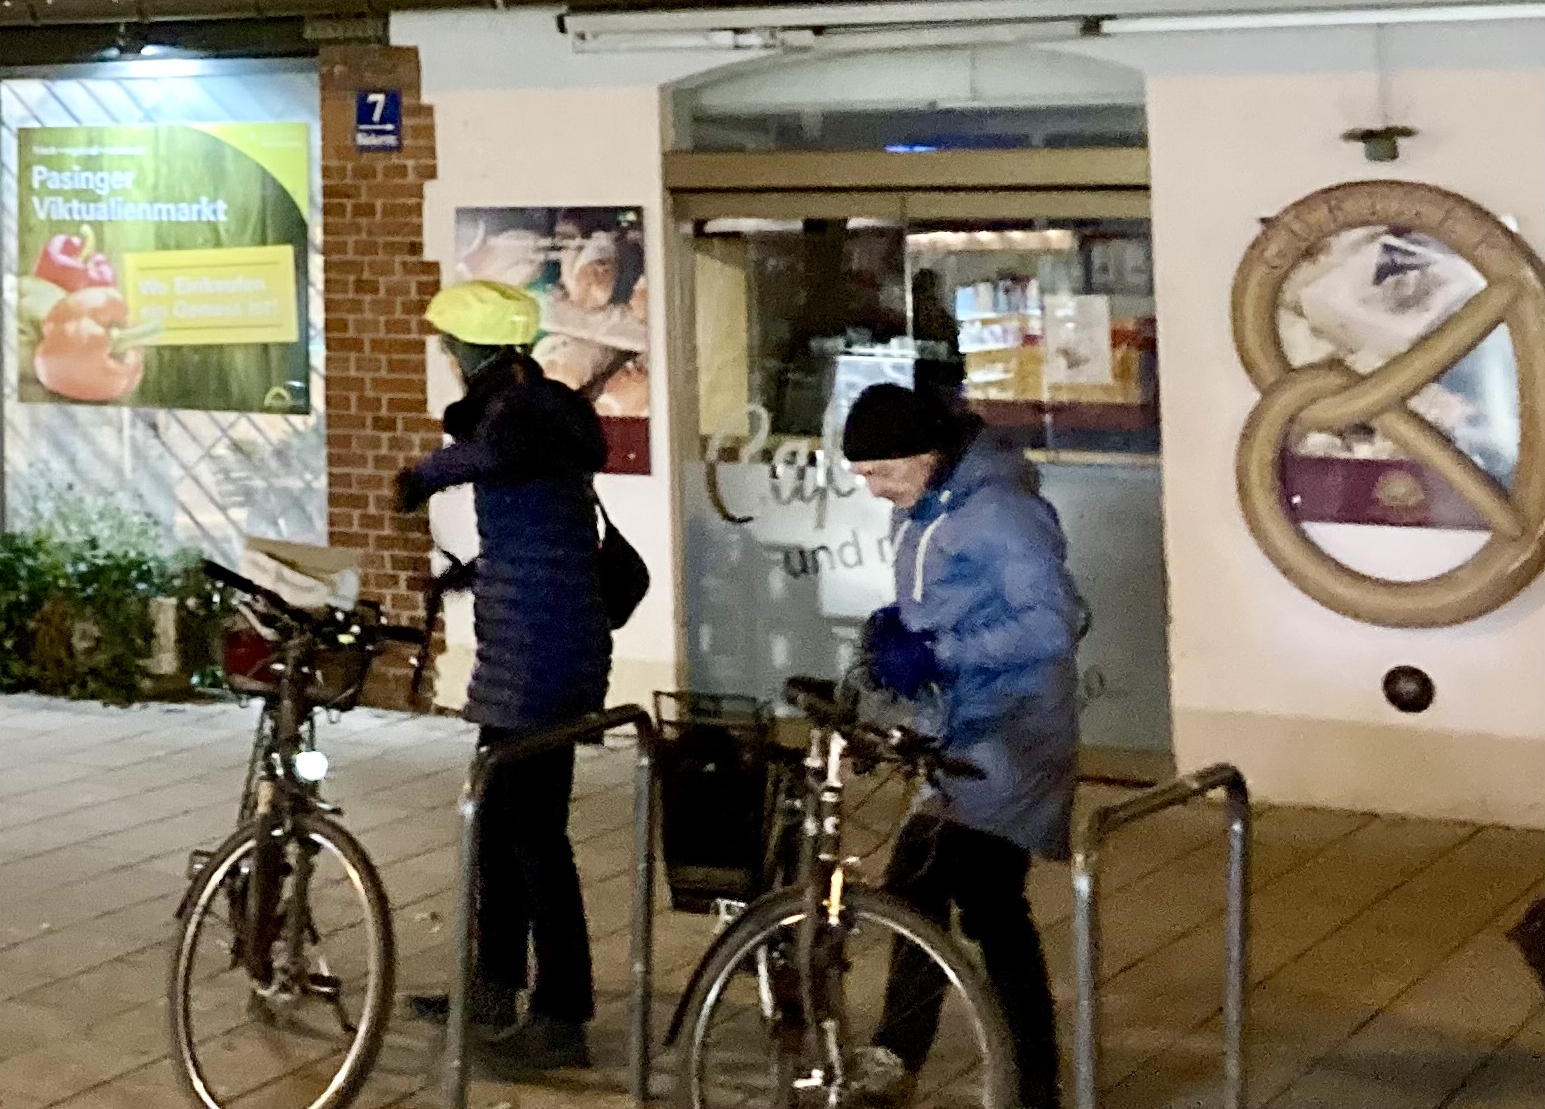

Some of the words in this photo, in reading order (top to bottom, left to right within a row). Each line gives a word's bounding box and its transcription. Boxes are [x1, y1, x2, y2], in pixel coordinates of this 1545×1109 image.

[366, 93, 386, 123] 7
[31, 165, 135, 195] Pasinger
[31, 196, 228, 222] Viktualienmarkt
